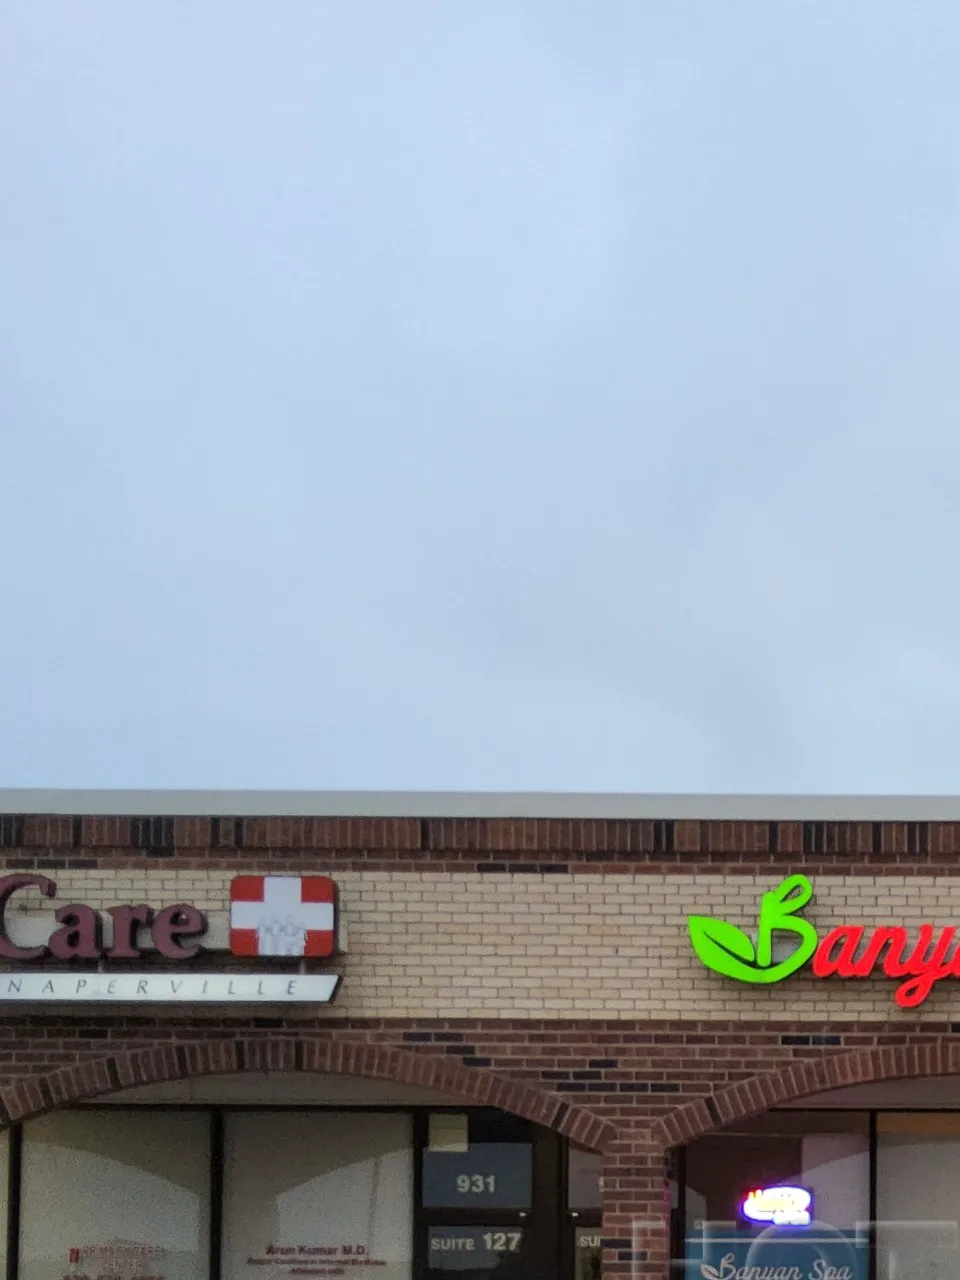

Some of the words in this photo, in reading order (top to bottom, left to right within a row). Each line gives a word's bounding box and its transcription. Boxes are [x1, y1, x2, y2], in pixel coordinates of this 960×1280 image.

[0, 873, 208, 960] Care
[7, 979, 300, 996] NAPERVILLE
[456, 1174, 496, 1192] 931
[431, 1238, 475, 1250] SUITE
[483, 1232, 521, 1250] 127
